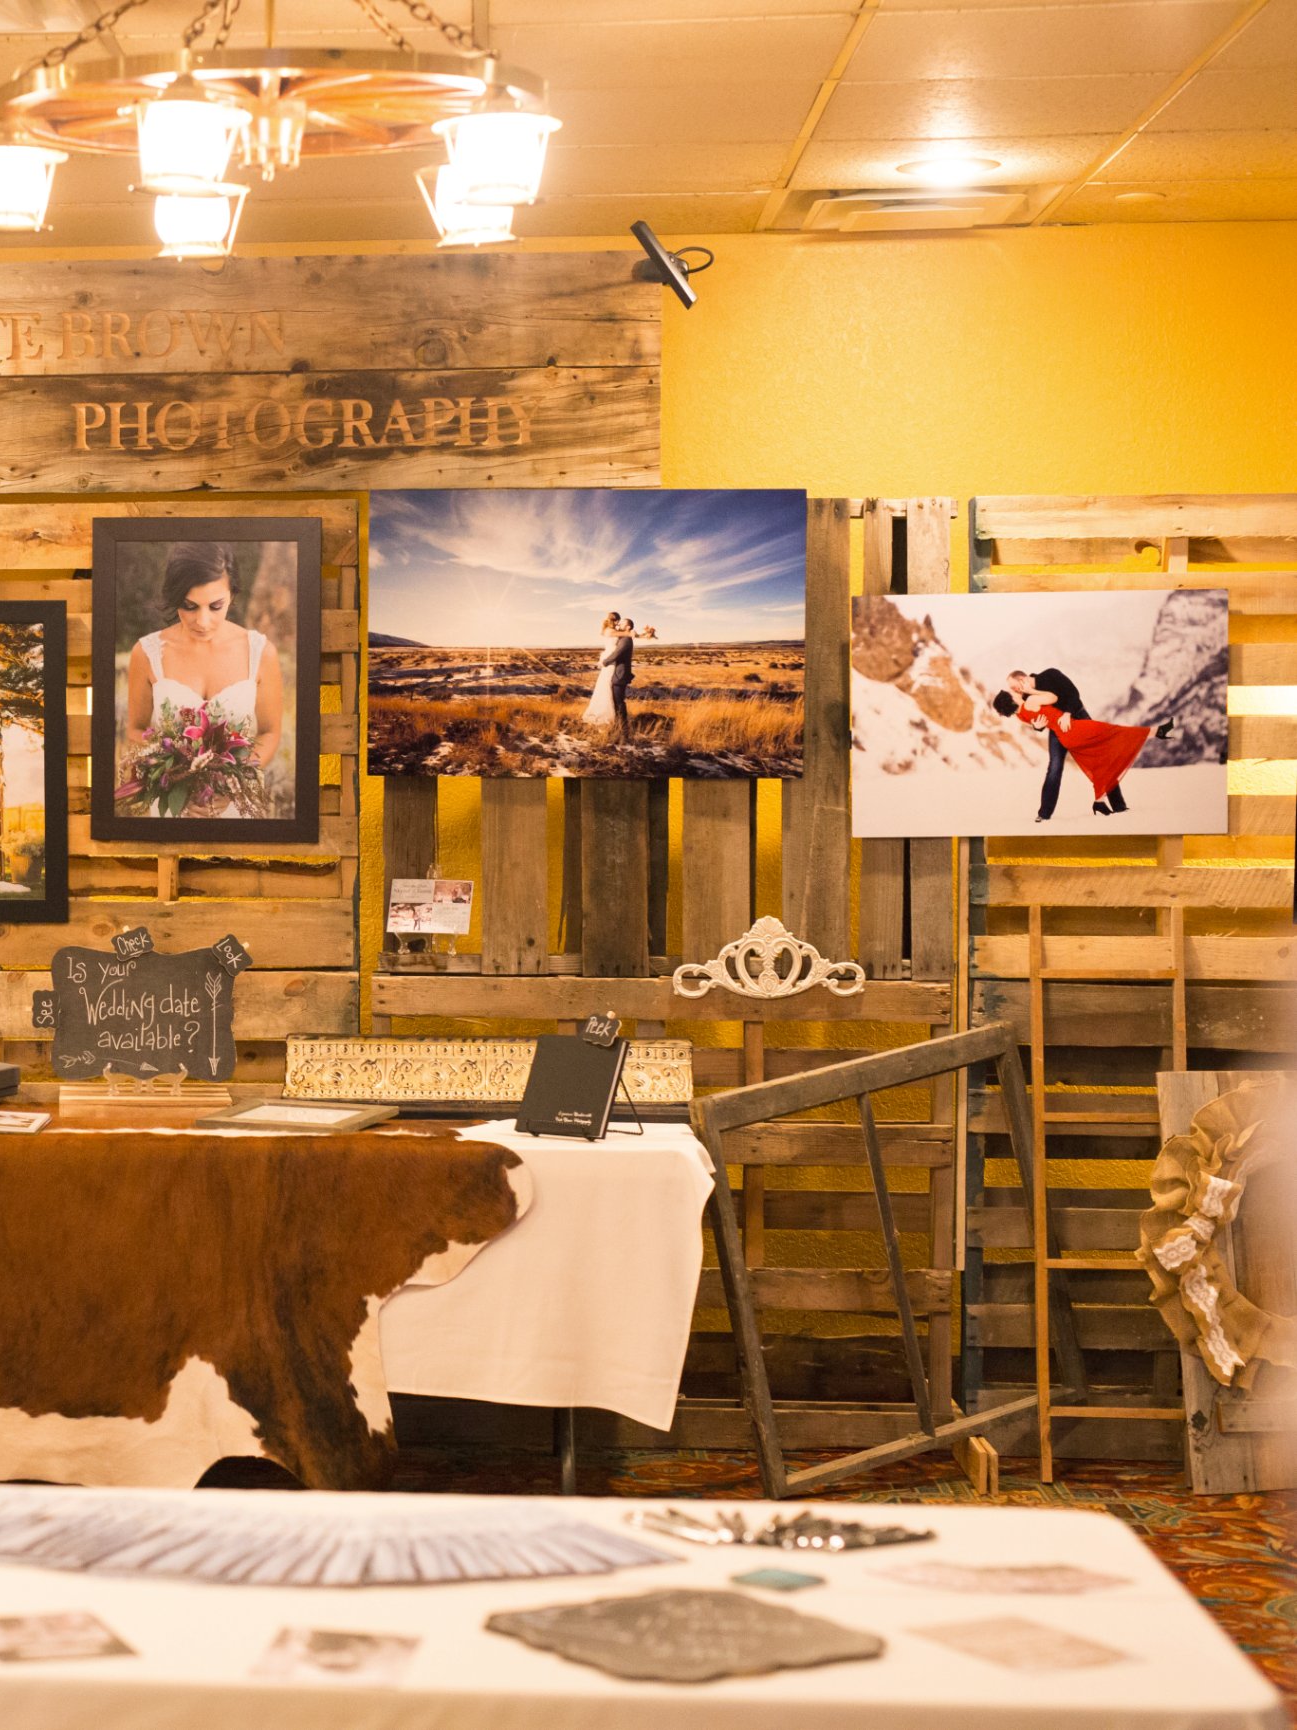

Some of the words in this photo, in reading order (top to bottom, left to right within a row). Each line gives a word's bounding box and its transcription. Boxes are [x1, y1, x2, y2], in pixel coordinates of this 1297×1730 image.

[57, 309, 286, 360] BROWN
[71, 396, 543, 451] PHOTOGRAPHY
[116, 932, 150, 955] Check
[66, 956, 87, 983] Is
[98, 960, 136, 984] your
[36, 999, 55, 1025] See
[159, 983, 201, 1017] date
[97, 1020, 200, 1053] available?
[585, 1016, 612, 1037] Peek
